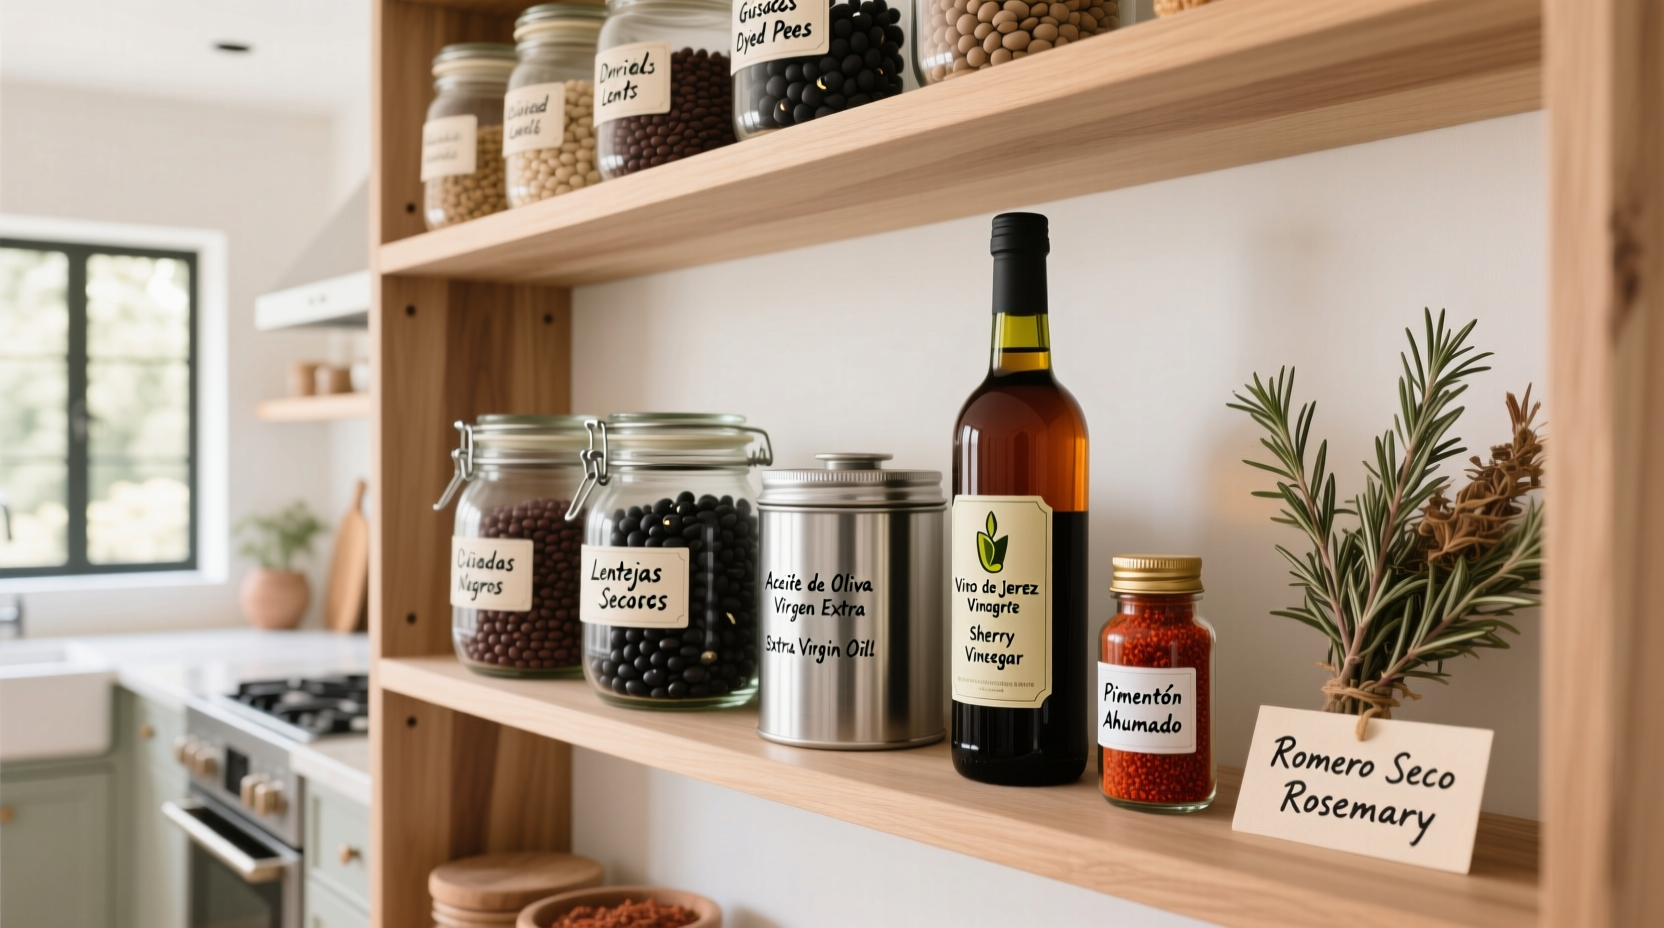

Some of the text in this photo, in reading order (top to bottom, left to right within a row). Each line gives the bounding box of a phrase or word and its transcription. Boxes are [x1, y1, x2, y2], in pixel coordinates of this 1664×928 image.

[772, 19, 812, 43] Pees
[765, 571, 873, 593] Aceite de Oliva
[982, 579, 997, 594] de
[998, 580, 1039, 598] Jerez
[774, 596, 865, 623] Virgen Extra
[969, 624, 1015, 649] Sherry
[798, 637, 840, 664] Virgin
[1104, 682, 1182, 706] Pimentón
[1102, 709, 1182, 734] Ahumado
[1270, 735, 1456, 790] Romero Seco
[1280, 780, 1436, 847] Rosemary
